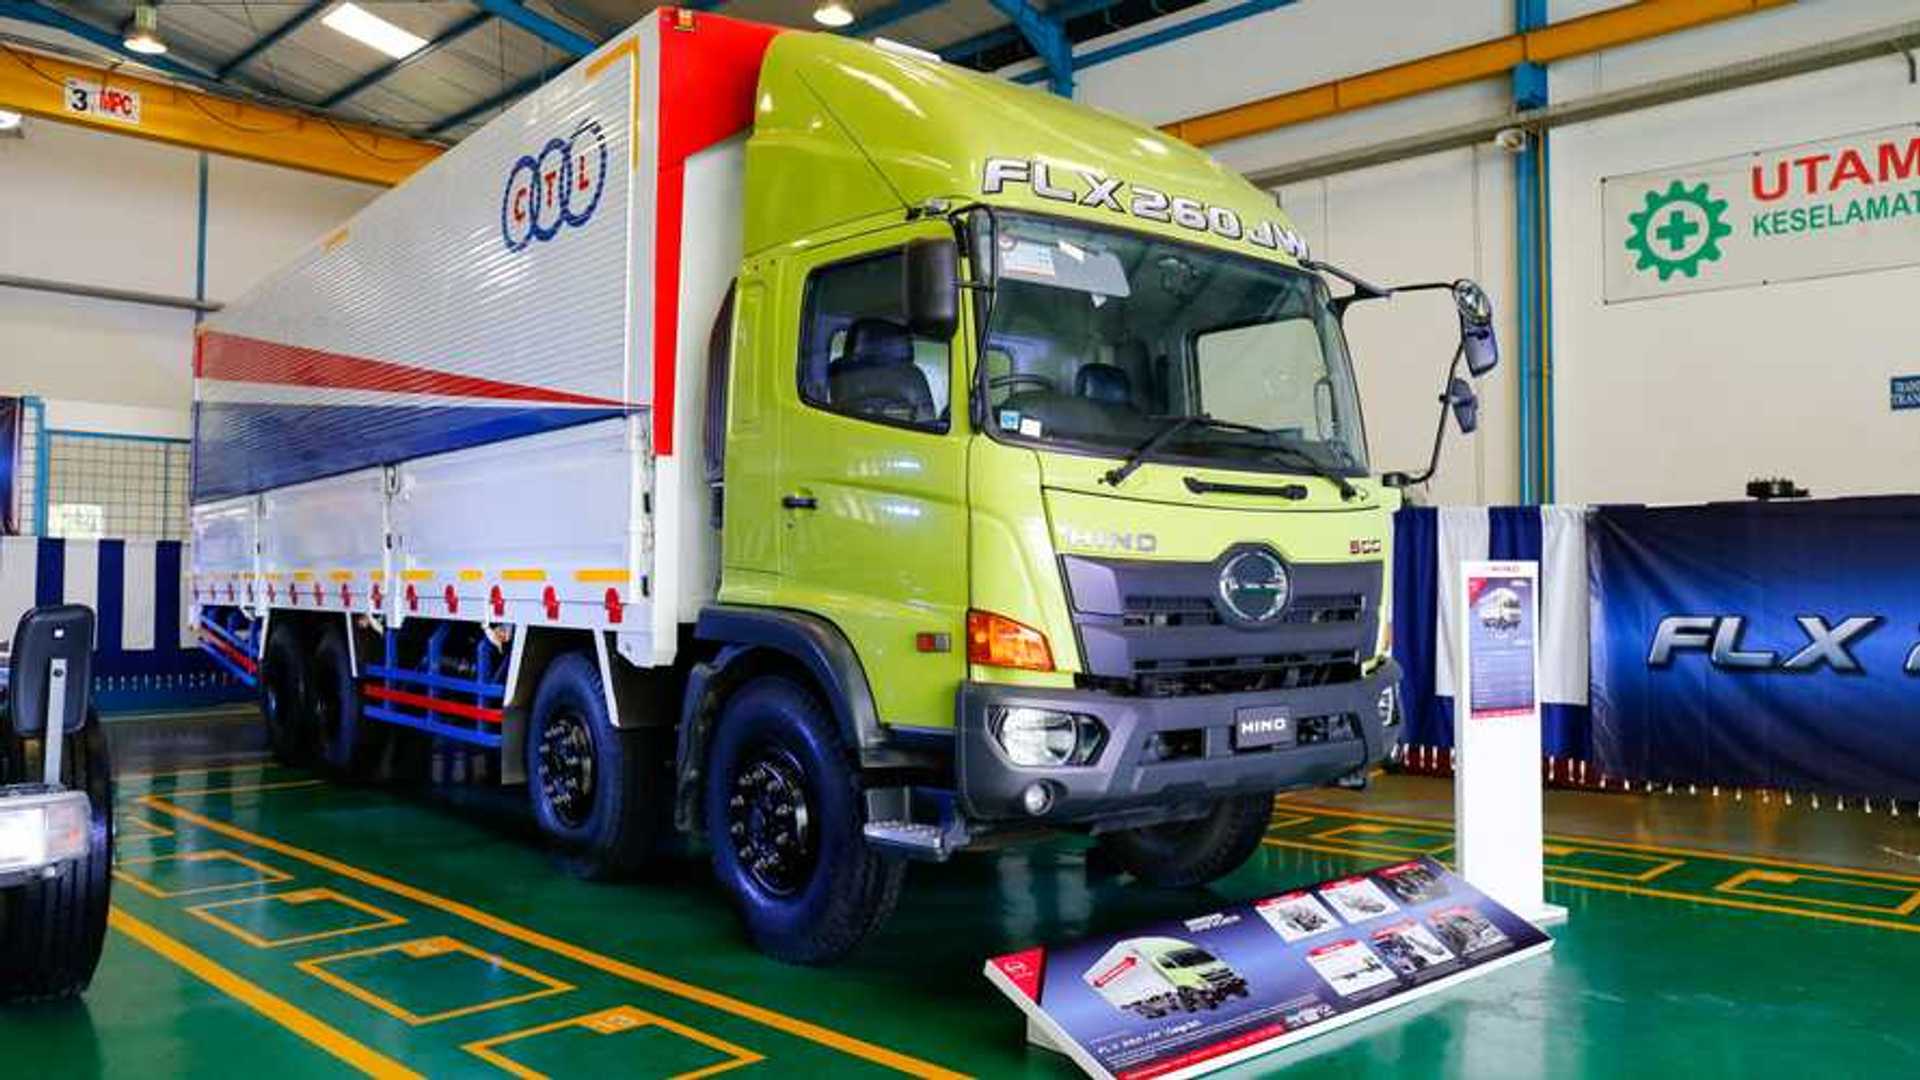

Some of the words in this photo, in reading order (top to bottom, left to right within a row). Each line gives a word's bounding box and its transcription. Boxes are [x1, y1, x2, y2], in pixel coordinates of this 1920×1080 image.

[72, 88, 88, 111] 3
[1648, 613, 1886, 674] FLX
[1241, 717, 1287, 735] HINO
